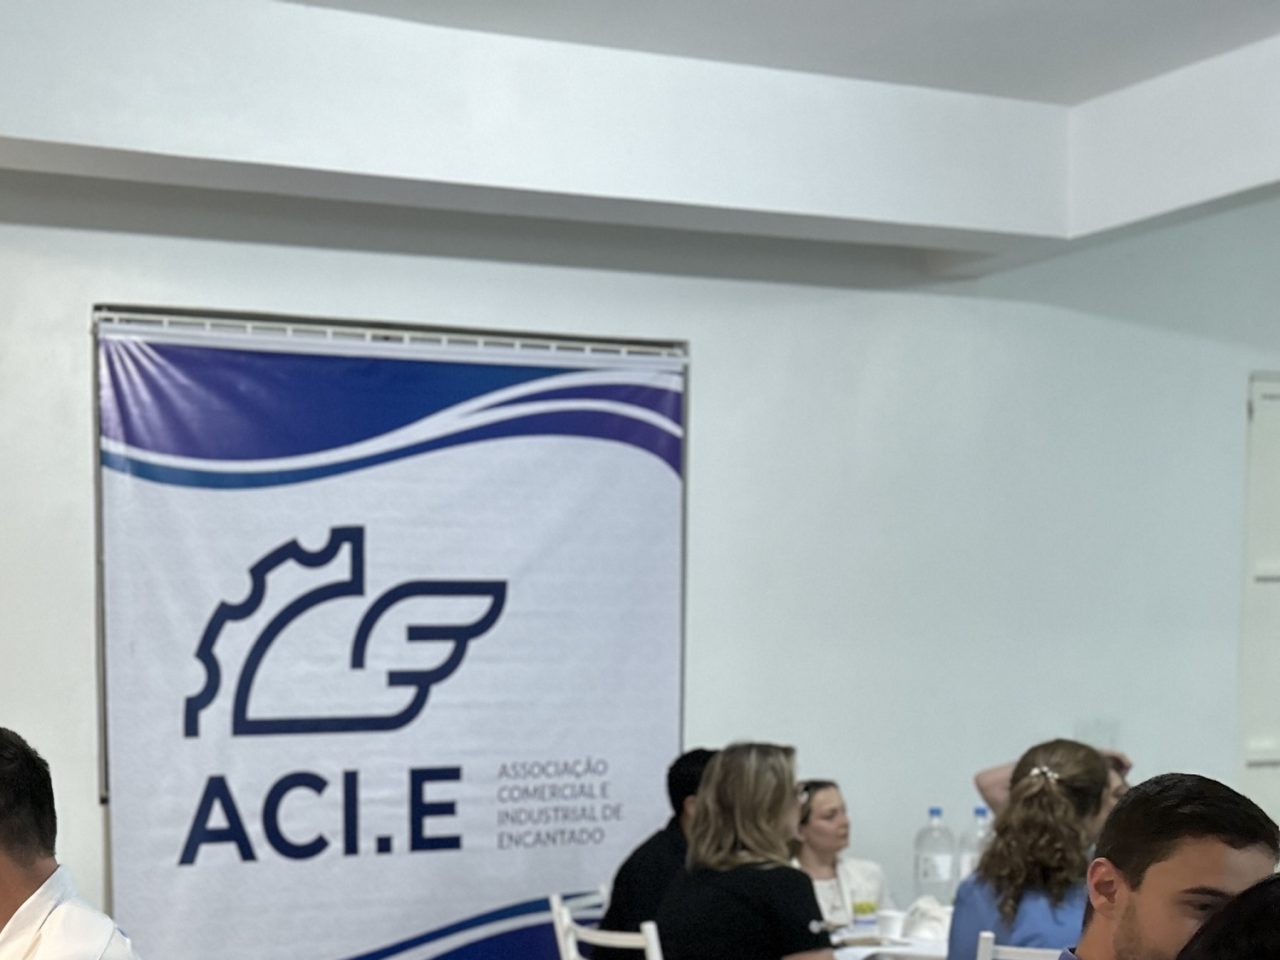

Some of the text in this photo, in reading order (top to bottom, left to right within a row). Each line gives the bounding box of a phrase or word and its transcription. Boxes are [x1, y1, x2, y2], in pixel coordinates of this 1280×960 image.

[498, 756, 609, 780] ASSOCIAÇÃO
[497, 781, 610, 803] COMERCIAL E
[178, 766, 462, 866] ACI.E
[497, 802, 622, 826] INDUSTRIAL DE
[497, 827, 605, 850] ENCANTADO
